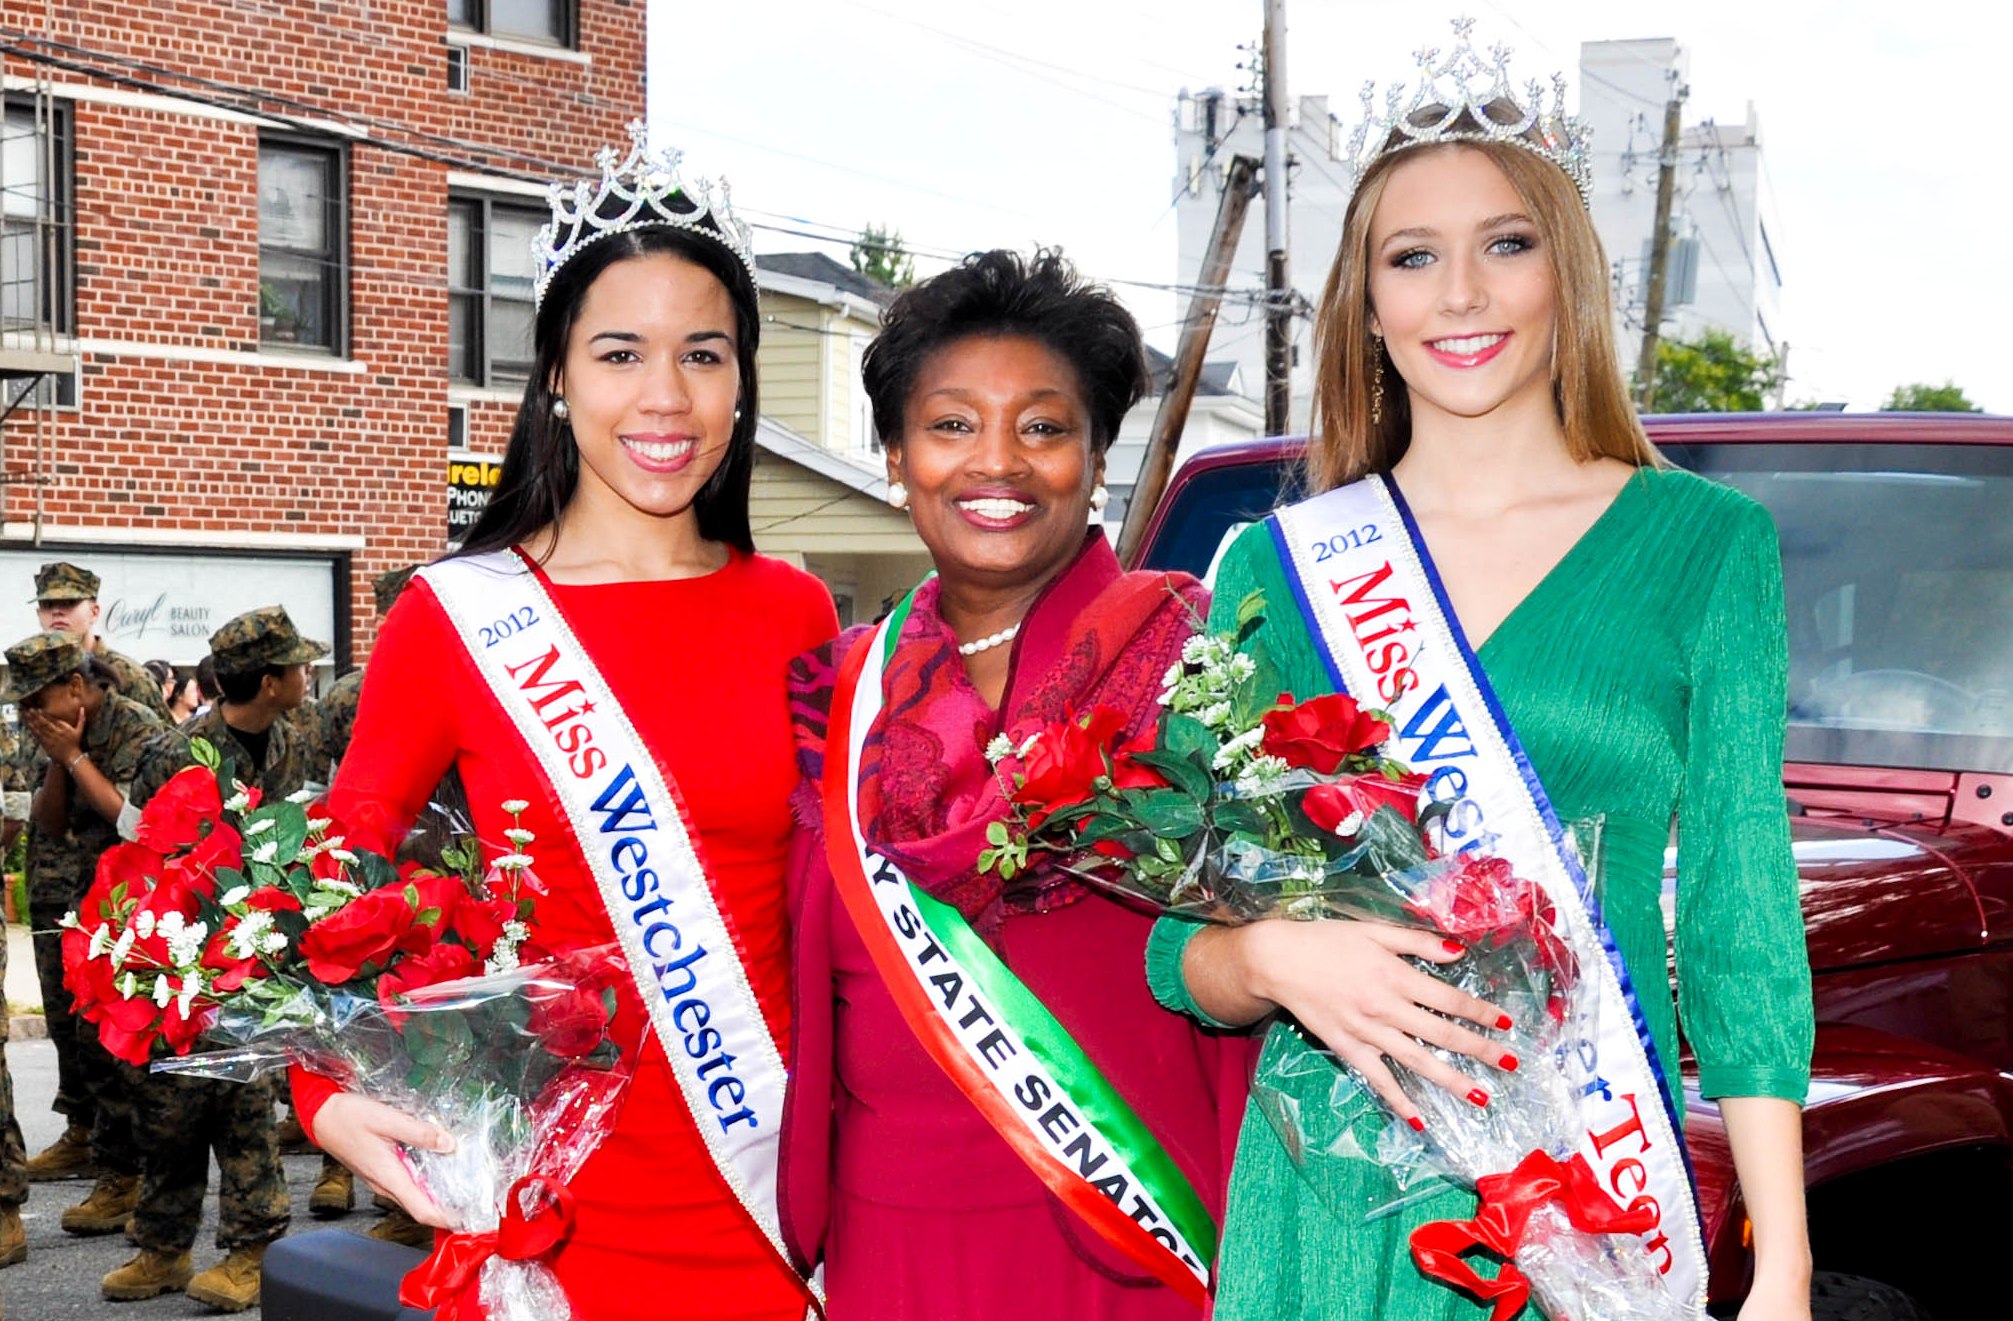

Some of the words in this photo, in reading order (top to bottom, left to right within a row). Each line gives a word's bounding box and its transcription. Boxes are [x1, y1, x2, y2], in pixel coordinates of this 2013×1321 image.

[1311, 524, 1383, 563] 2012
[170, 606, 210, 621] BEAUTY
[170, 622, 210, 637] SALON
[478, 605, 541, 649] 2012
[1329, 560, 1422, 703] Miss
[1400, 682, 1613, 1102] Wester
[504, 642, 607, 780] Miss
[590, 762, 759, 1135] Westchester
[864, 845, 900, 886] Y
[893, 903, 1018, 1071] STATE
